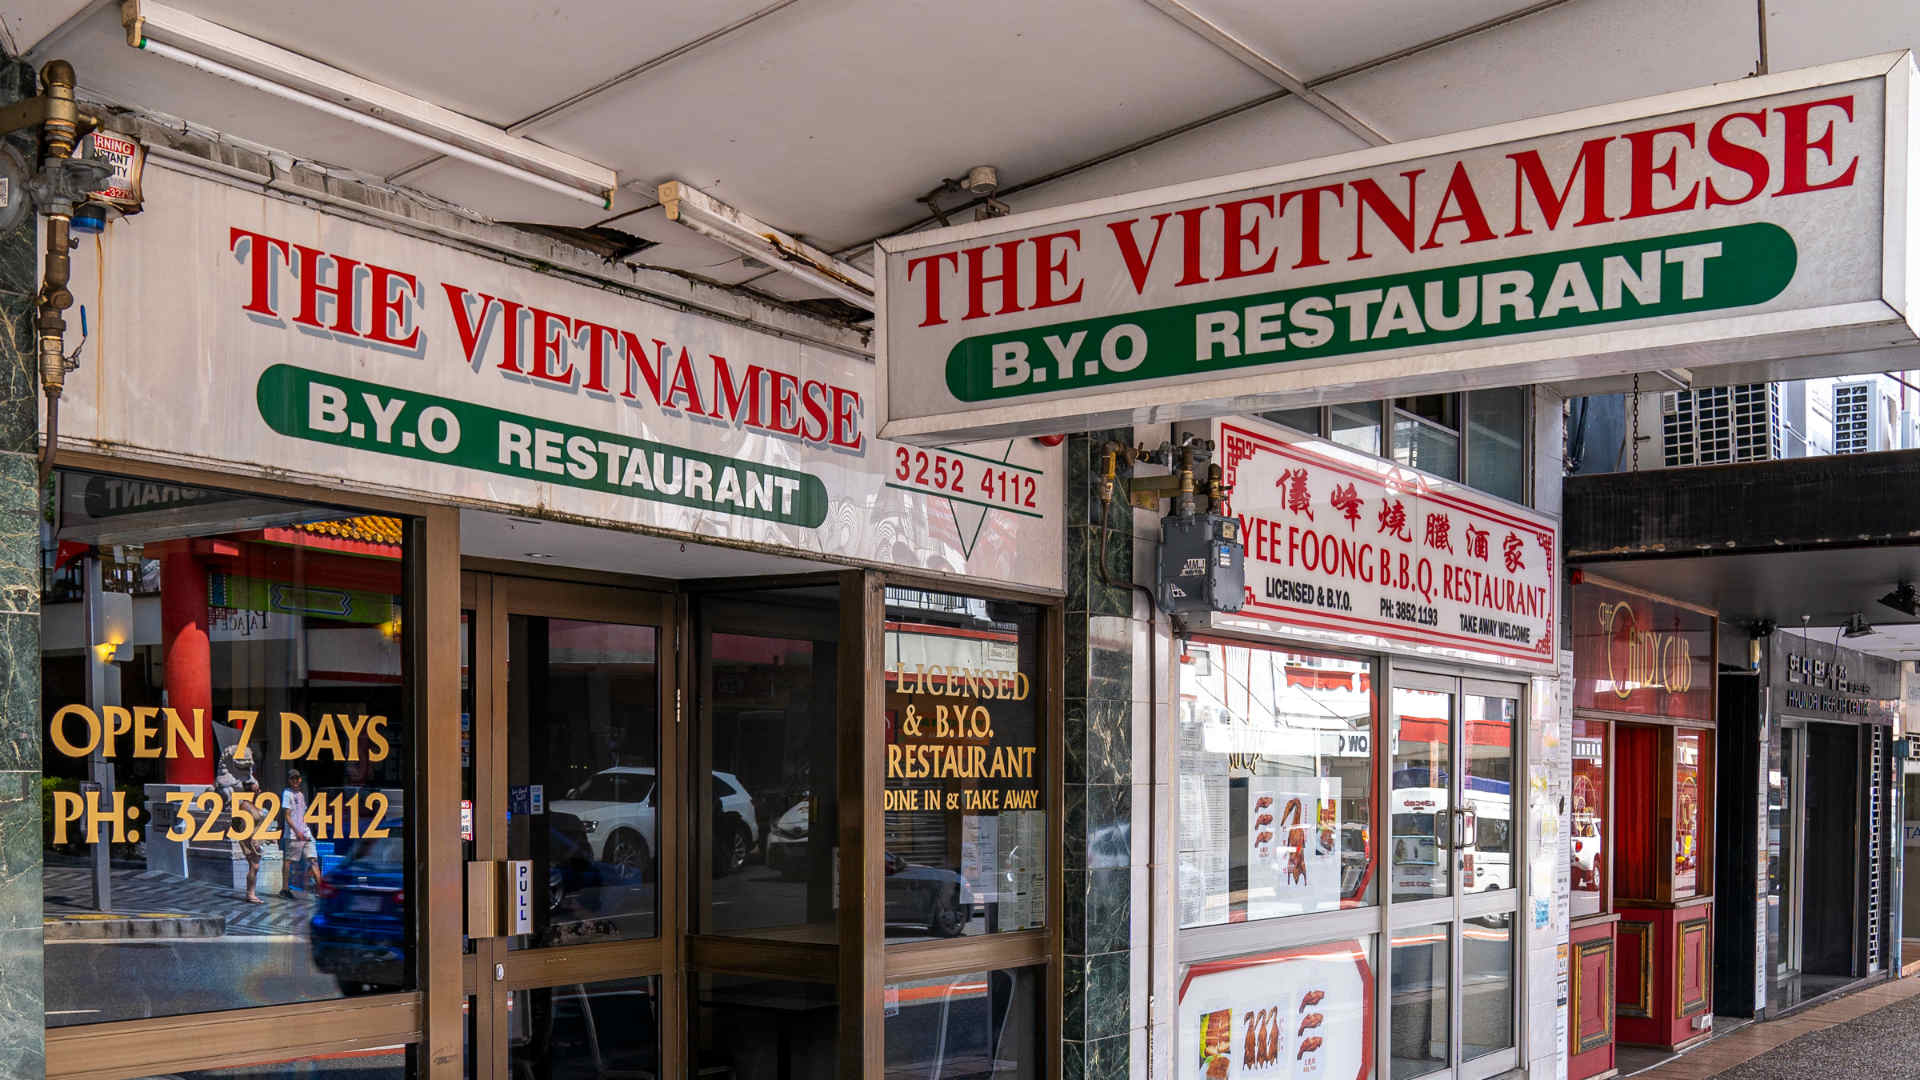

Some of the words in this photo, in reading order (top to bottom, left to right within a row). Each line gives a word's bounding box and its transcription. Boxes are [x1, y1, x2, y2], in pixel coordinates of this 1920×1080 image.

[94, 134, 132, 154] RNING
[908, 229, 1085, 328] THE
[1107, 95, 1859, 296] VIETNAMESE
[230, 227, 426, 359] THE
[440, 282, 866, 457] VIETNAMESE
[991, 322, 1149, 389] B.Y.O
[1195, 241, 1723, 362] RESTAURANT
[308, 381, 461, 455] B.Y.O
[498, 420, 801, 516] RESTAURANT
[895, 446, 964, 493] 3252
[980, 467, 1037, 509] 4112
[1238, 513, 1281, 565] YEE
[1288, 526, 1374, 584] FOONG
[1380, 548, 1439, 605] B.B.Q.
[1443, 563, 1547, 620] RESTAURANT
[1266, 577, 1314, 606] LICENSED
[1316, 586, 1326, 607] &
[1380, 598, 1394, 619] PH:
[1395, 600, 1417, 623] 3852
[1418, 604, 1438, 627] 1193
[1459, 614, 1477, 634] TAKE
[1477, 618, 1498, 638] AWAY
[1498, 622, 1530, 644] WELCOME
[896, 661, 1029, 701] LICENSED
[1663, 635, 1692, 694] CLUB
[50, 704, 205, 759] OPEN
[227, 710, 260, 760] 7
[280, 711, 390, 762] DAYS
[903, 704, 922, 737] &
[936, 704, 994, 738] B.Y.O.
[887, 745, 1036, 778] RESTAURANT
[52, 791, 141, 844] PH:
[165, 791, 282, 842] 3252
[303, 791, 390, 840] 4112
[884, 790, 918, 811] DINE
[924, 789, 941, 811] IN
[946, 792, 959, 811] &
[964, 789, 999, 811] TAKE
[1003, 789, 1039, 810] AWAY
[518, 866, 528, 921] PULL
